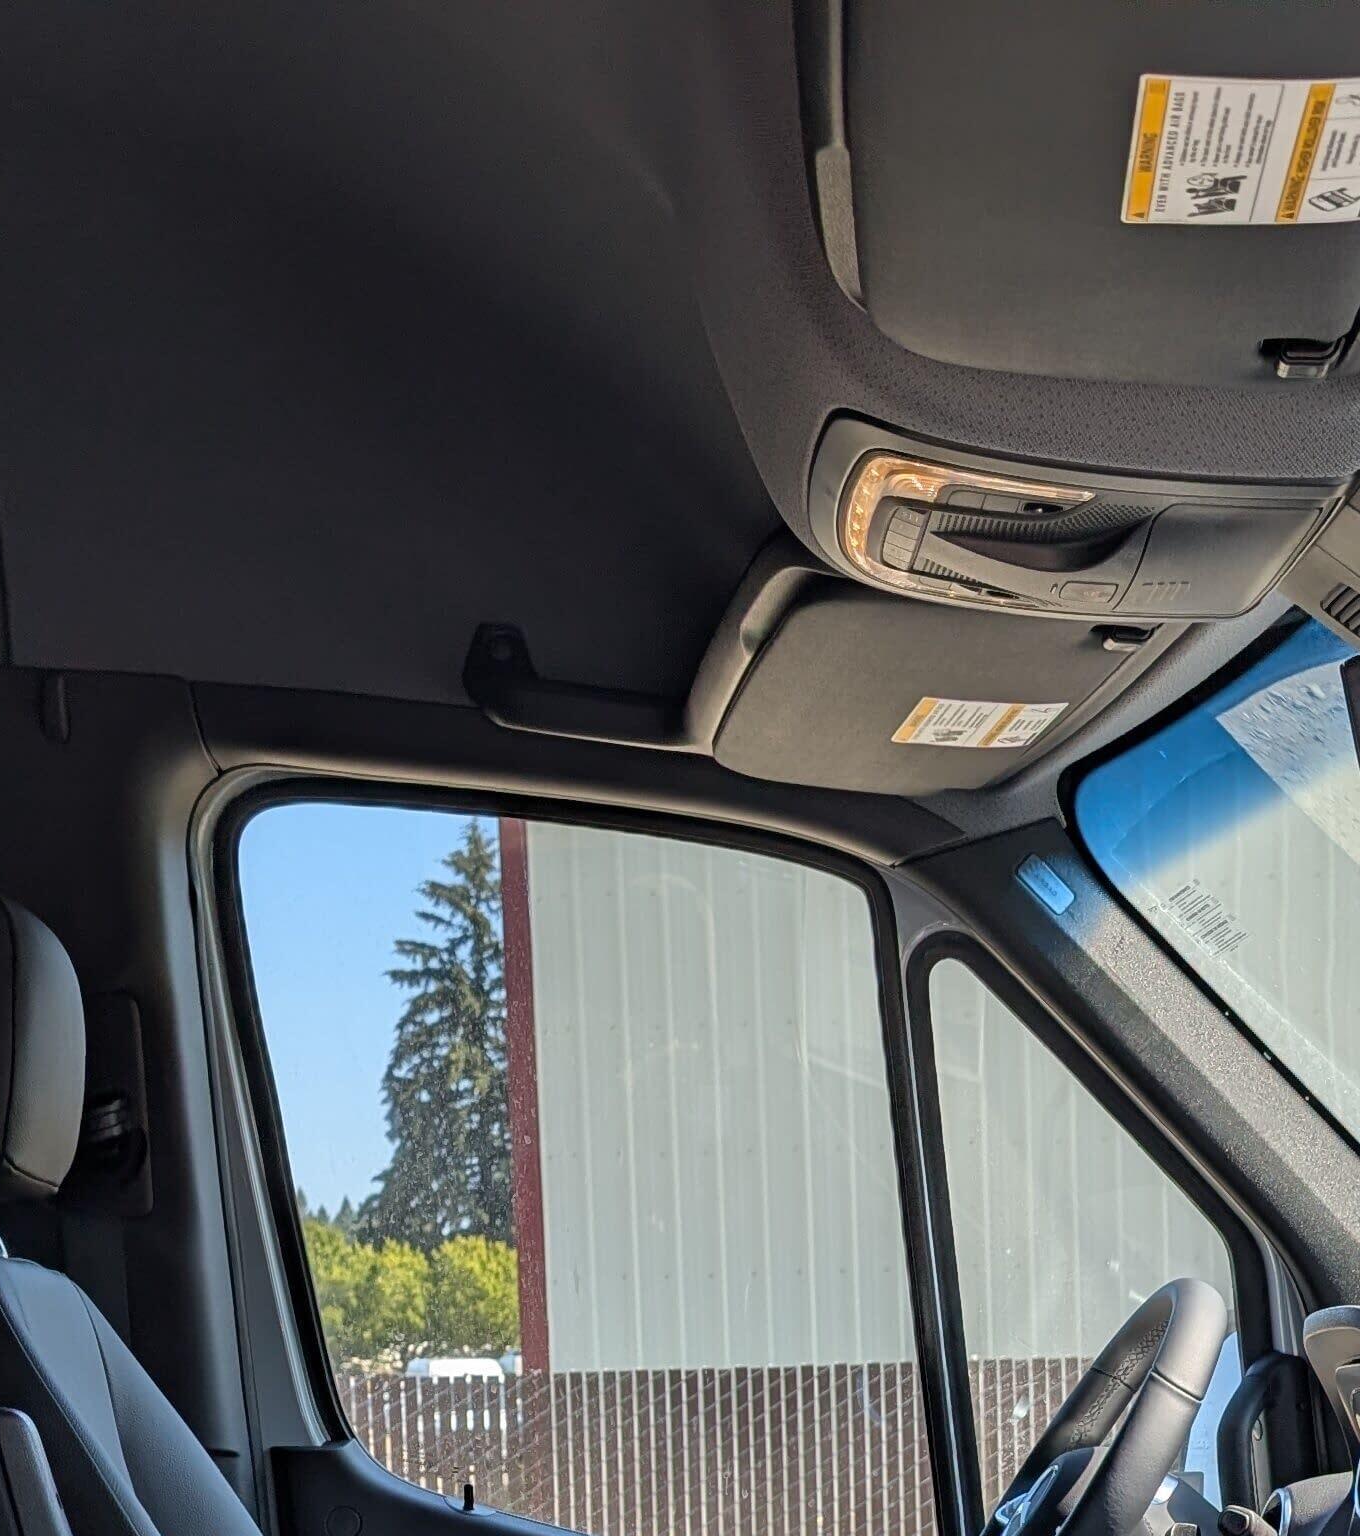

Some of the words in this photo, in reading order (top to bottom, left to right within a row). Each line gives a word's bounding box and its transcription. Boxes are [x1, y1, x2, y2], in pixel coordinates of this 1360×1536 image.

[1168, 113, 1181, 127] AIR
[1137, 132, 1157, 172] WARNING
[1162, 130, 1178, 169] ADVANCED
